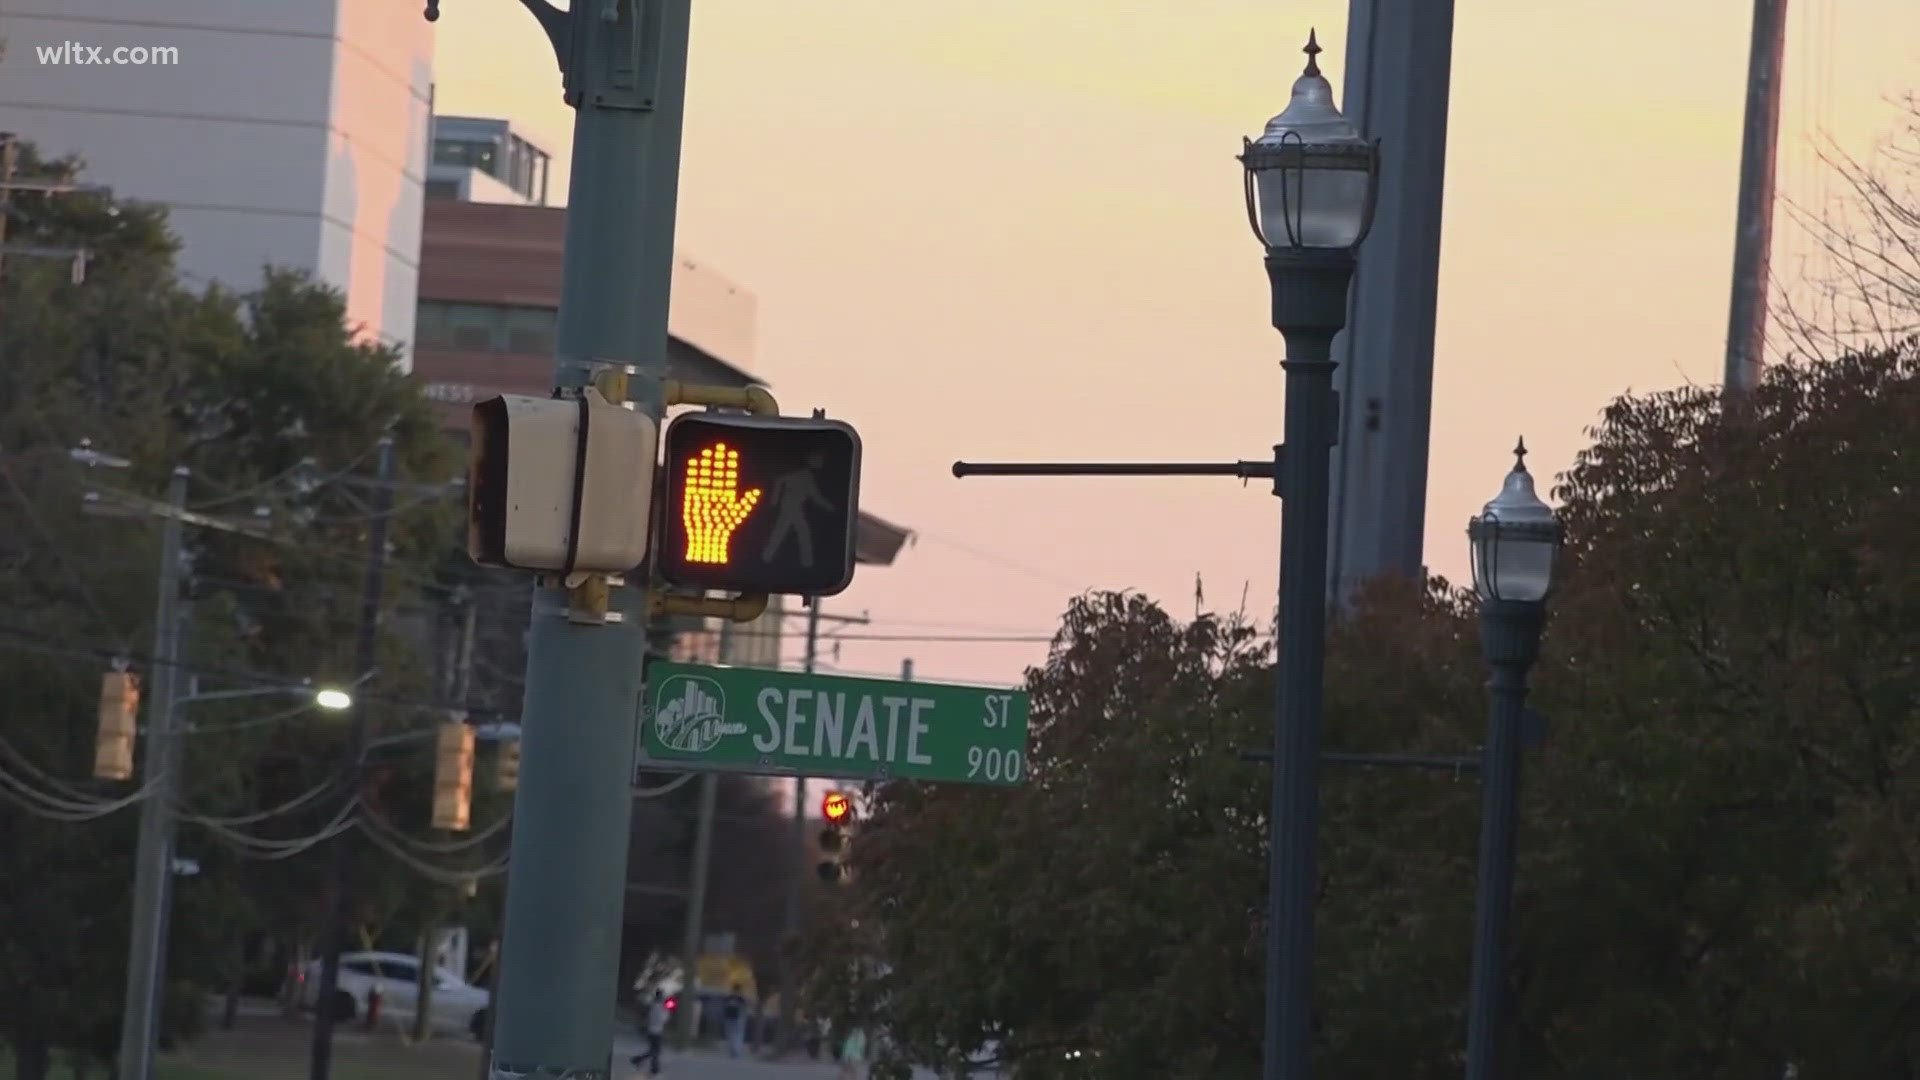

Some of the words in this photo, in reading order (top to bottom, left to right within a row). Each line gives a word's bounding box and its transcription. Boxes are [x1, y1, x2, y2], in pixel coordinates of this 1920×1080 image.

[753, 687, 936, 765] SENATE
[983, 694, 1012, 729] ST
[967, 746, 1021, 783] 900
